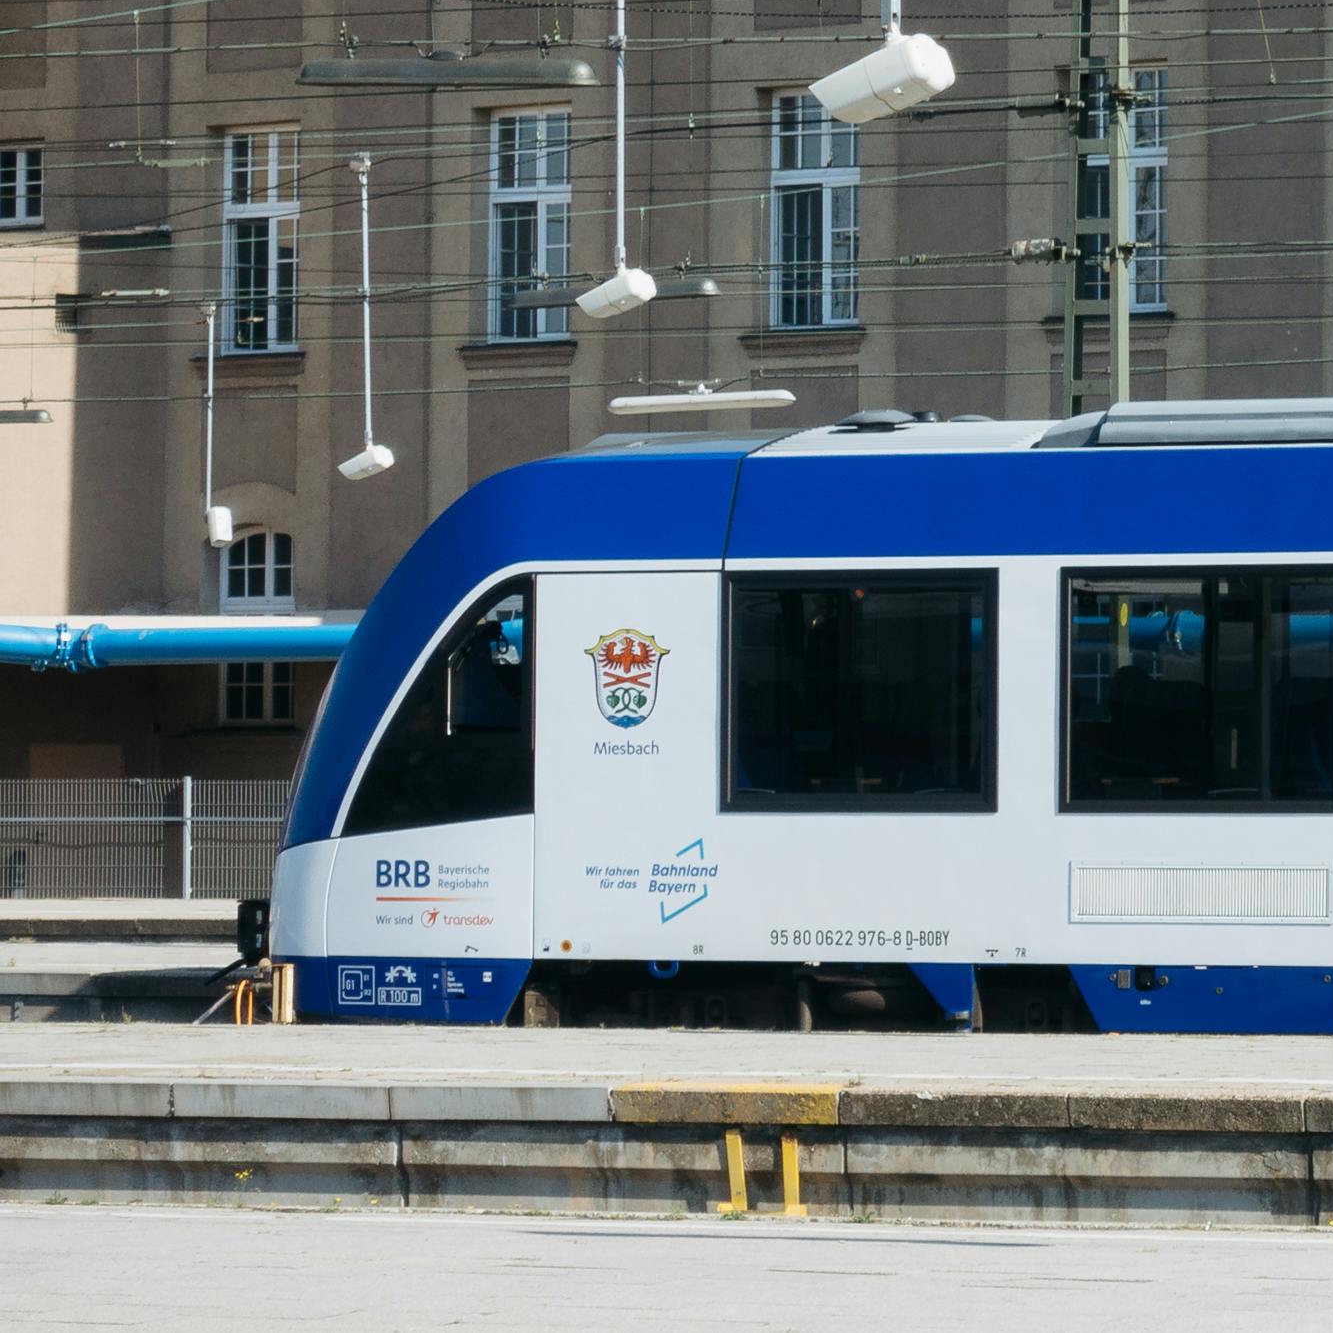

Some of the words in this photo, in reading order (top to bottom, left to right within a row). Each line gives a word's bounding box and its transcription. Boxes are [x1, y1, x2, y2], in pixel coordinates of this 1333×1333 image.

[593, 740, 660, 755] Miesbach
[376, 860, 431, 888] BRB
[438, 865, 490, 876] Bayerische
[585, 866, 602, 876] Wir
[604, 866, 640, 876] fahren
[651, 864, 719, 877] Bahnland
[438, 879, 489, 891] Regiobahn
[600, 879, 614, 889] für
[617, 879, 638, 889] das
[648, 880, 696, 895] Bayern
[375, 915, 392, 925] Wir
[394, 915, 414, 925] sind
[443, 914, 494, 925] transdev
[770, 930, 789, 946] 95
[792, 930, 811, 946] 80
[815, 930, 853, 946] 0622
[857, 930, 902, 946] 976-8
[692, 945, 704, 956] 8R
[1015, 947, 1027, 958] 7R
[345, 980, 355, 990] G1
[380, 991, 387, 1002] R
[390, 991, 408, 1002] 100
[410, 993, 419, 1002] m
